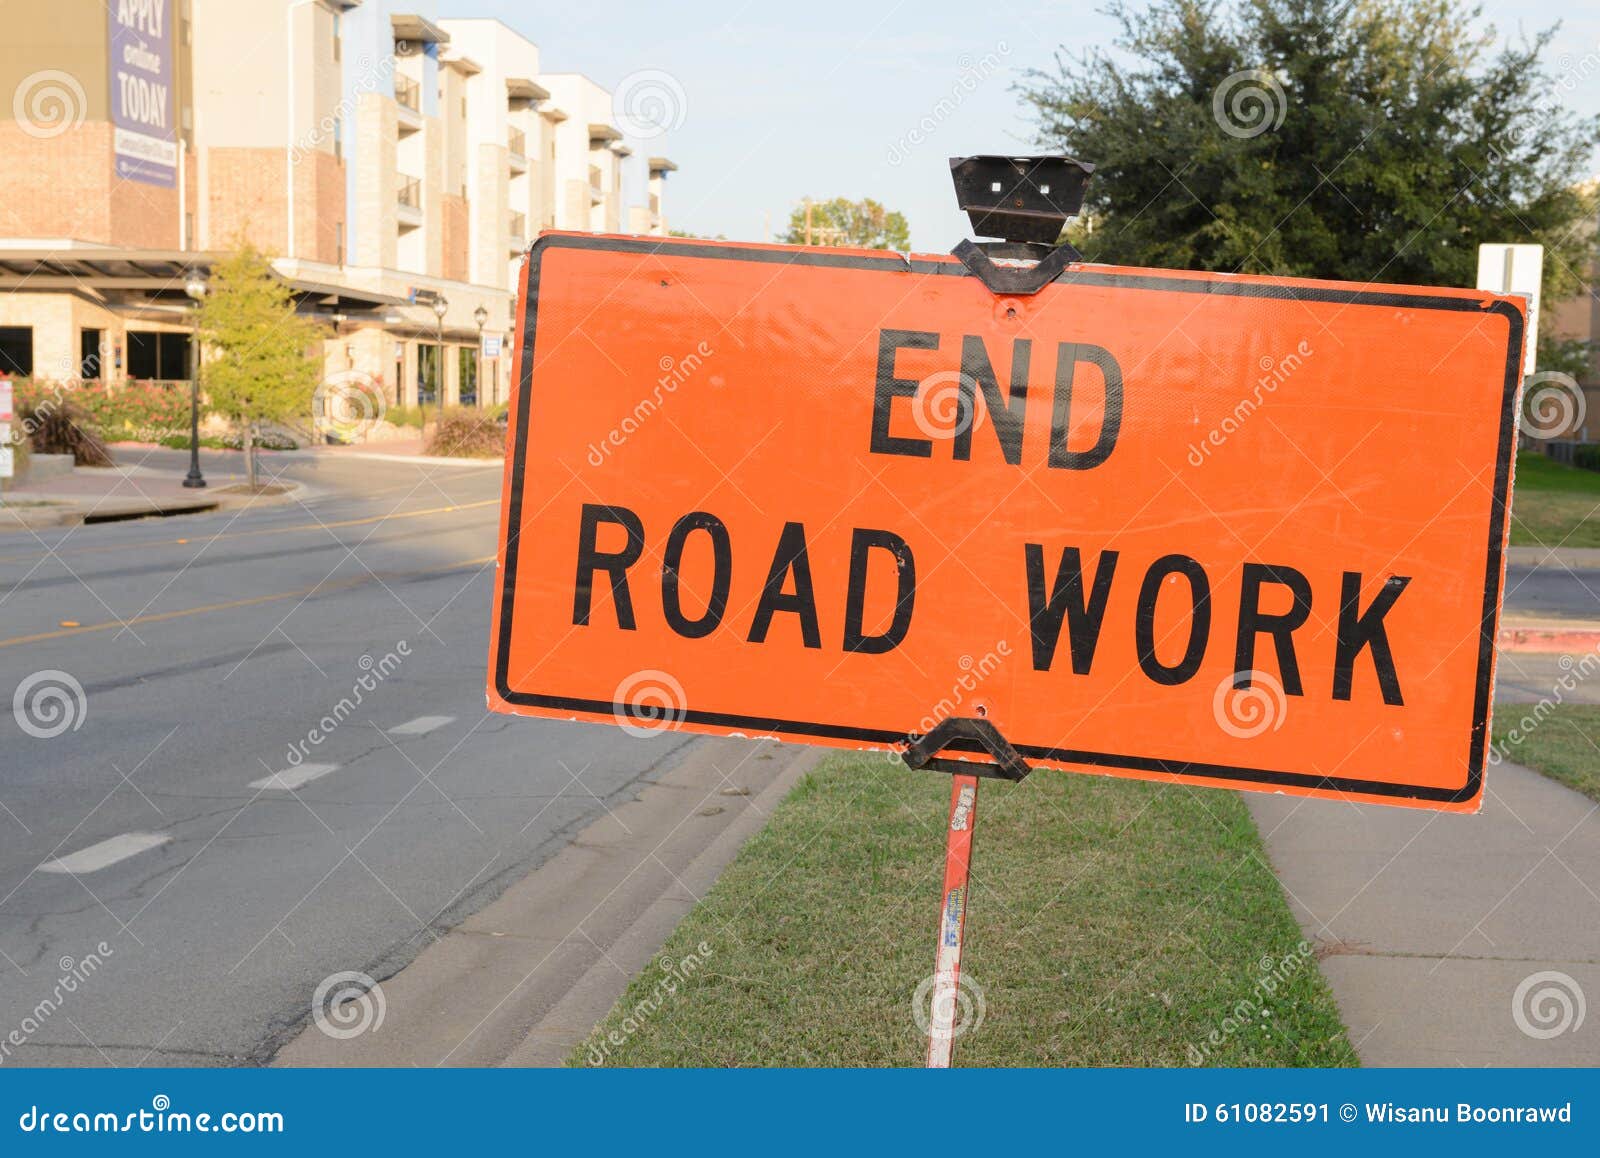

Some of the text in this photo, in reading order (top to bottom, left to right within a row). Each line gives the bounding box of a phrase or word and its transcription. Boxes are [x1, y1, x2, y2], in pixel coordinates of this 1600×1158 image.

[117, 0, 164, 39] APPLY
[117, 72, 167, 128] TODAY
[869, 327, 1124, 472] END
[572, 503, 1412, 706] ROAD WORK
